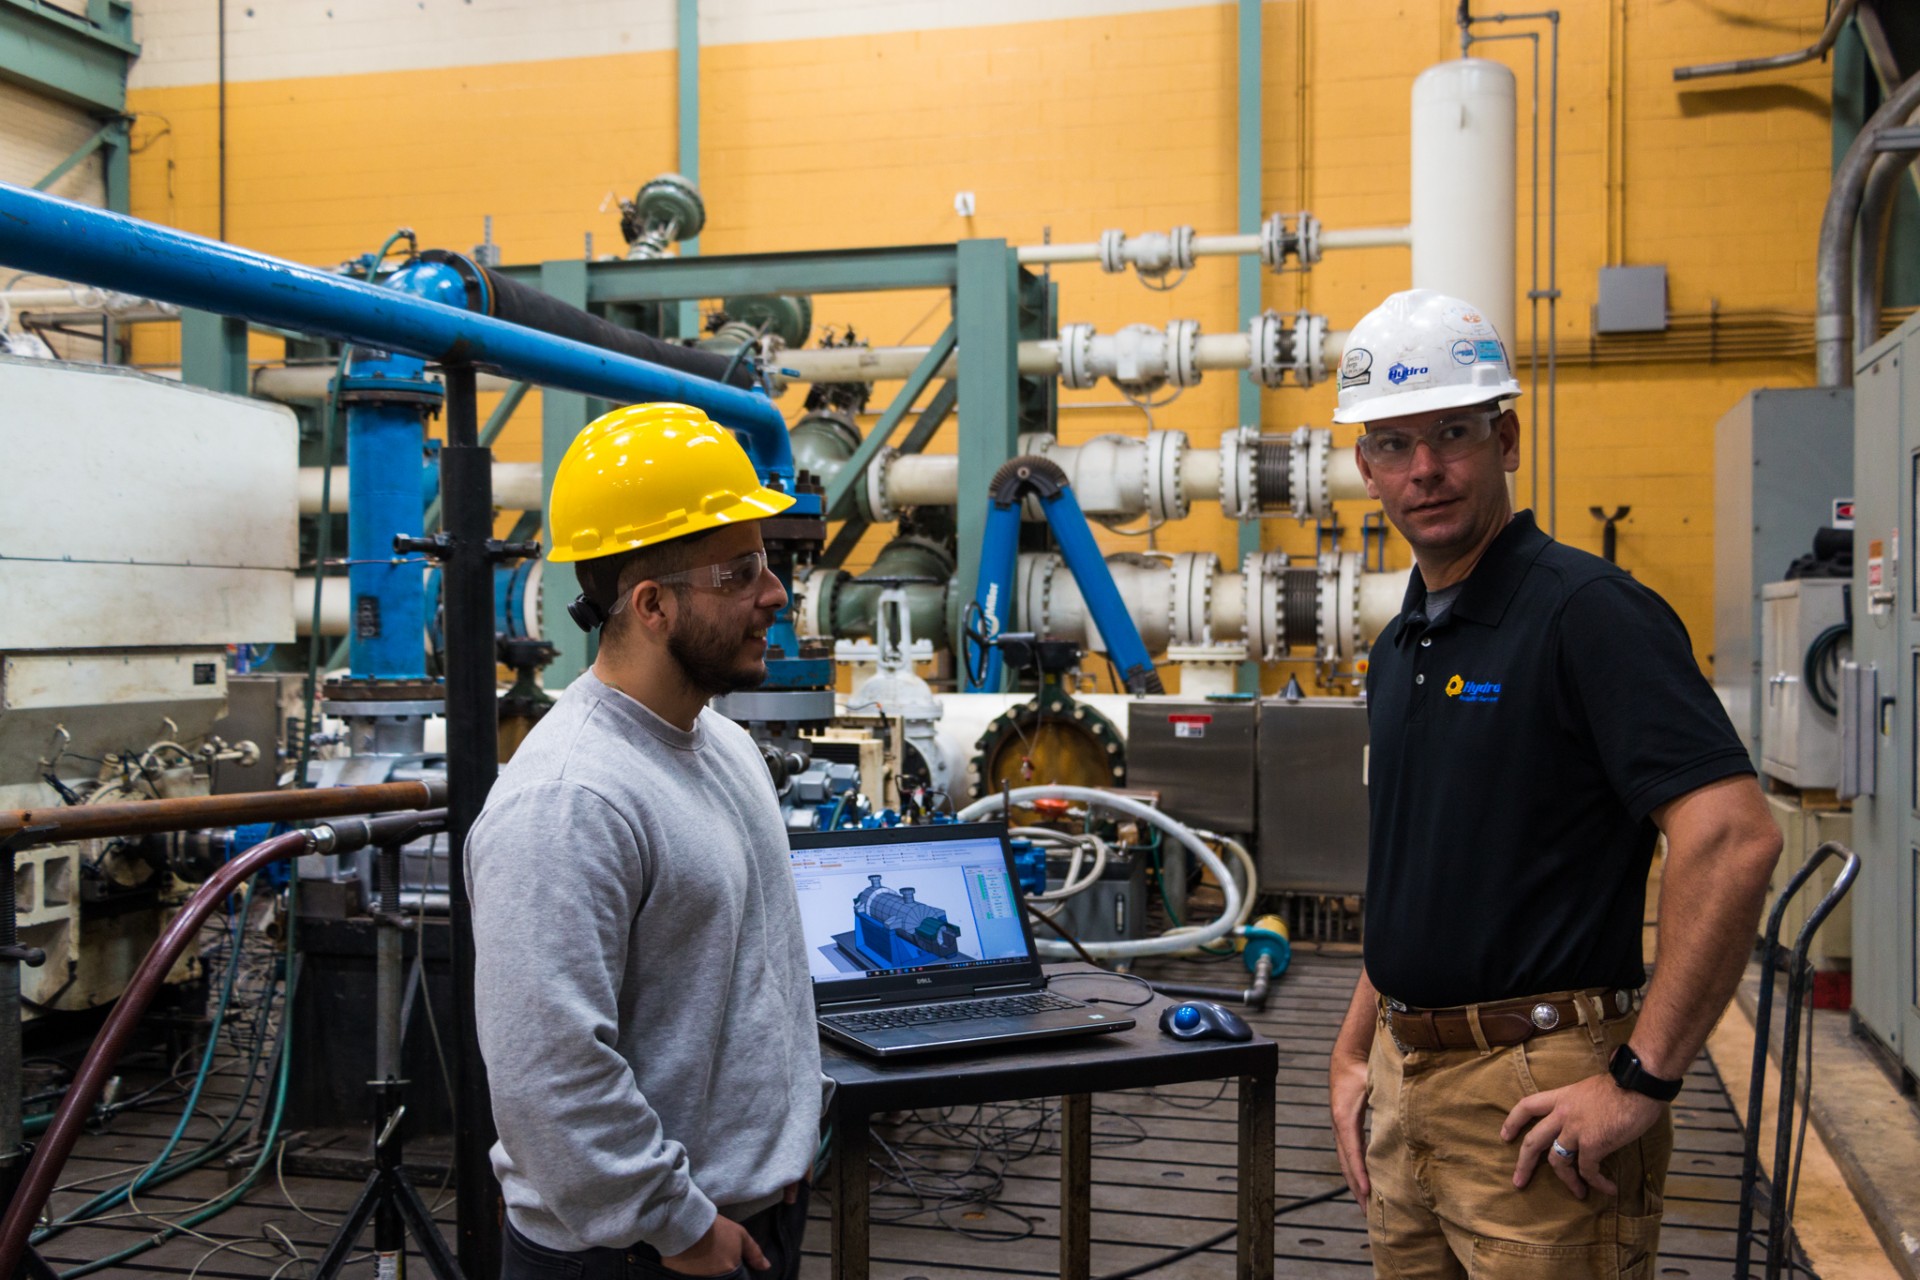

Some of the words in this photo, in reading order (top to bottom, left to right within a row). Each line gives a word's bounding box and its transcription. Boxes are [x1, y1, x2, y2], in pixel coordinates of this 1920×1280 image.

[1388, 366, 1429, 381] Hydro
[1462, 681, 1502, 695] Hydro
[916, 977, 932, 985] DELL
